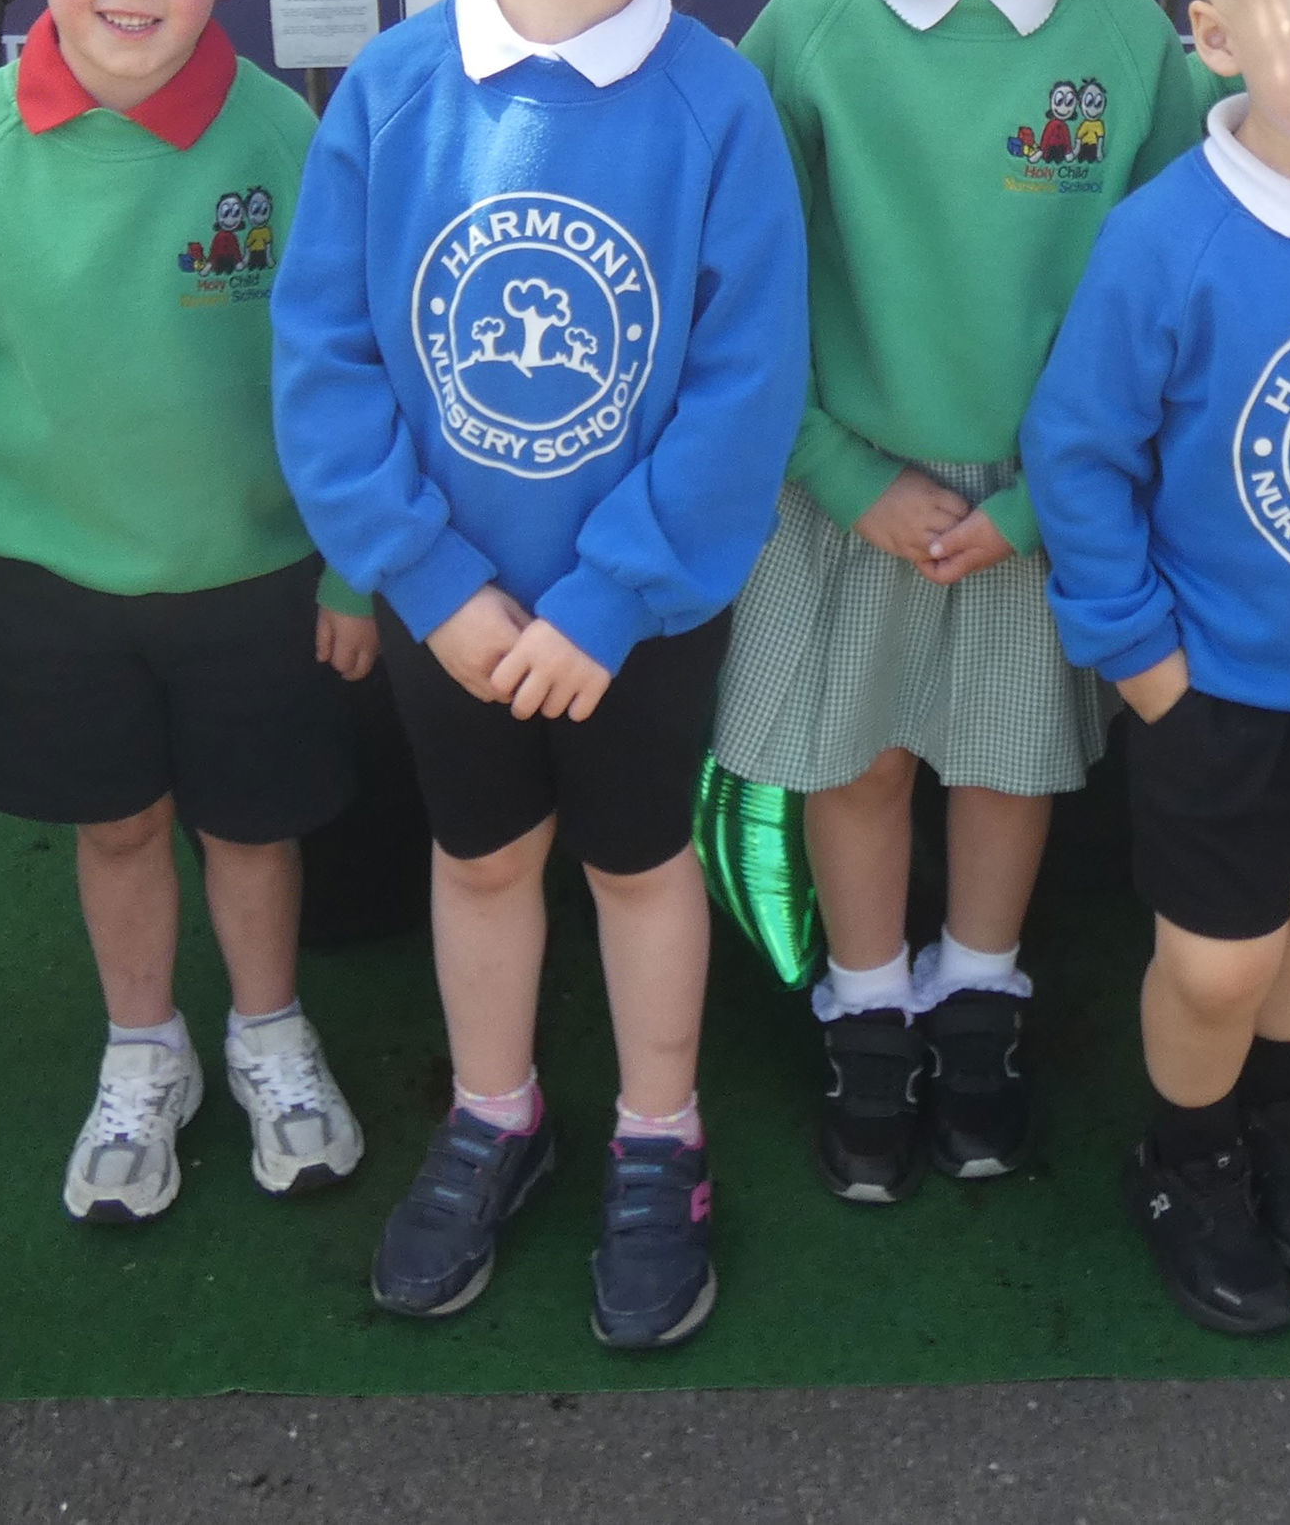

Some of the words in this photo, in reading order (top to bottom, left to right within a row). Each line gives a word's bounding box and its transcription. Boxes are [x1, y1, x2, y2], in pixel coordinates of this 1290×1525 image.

[441, 209, 642, 296] HARMONY
[428, 333, 528, 459] NURSERY
[533, 361, 639, 464] SCHOOL
